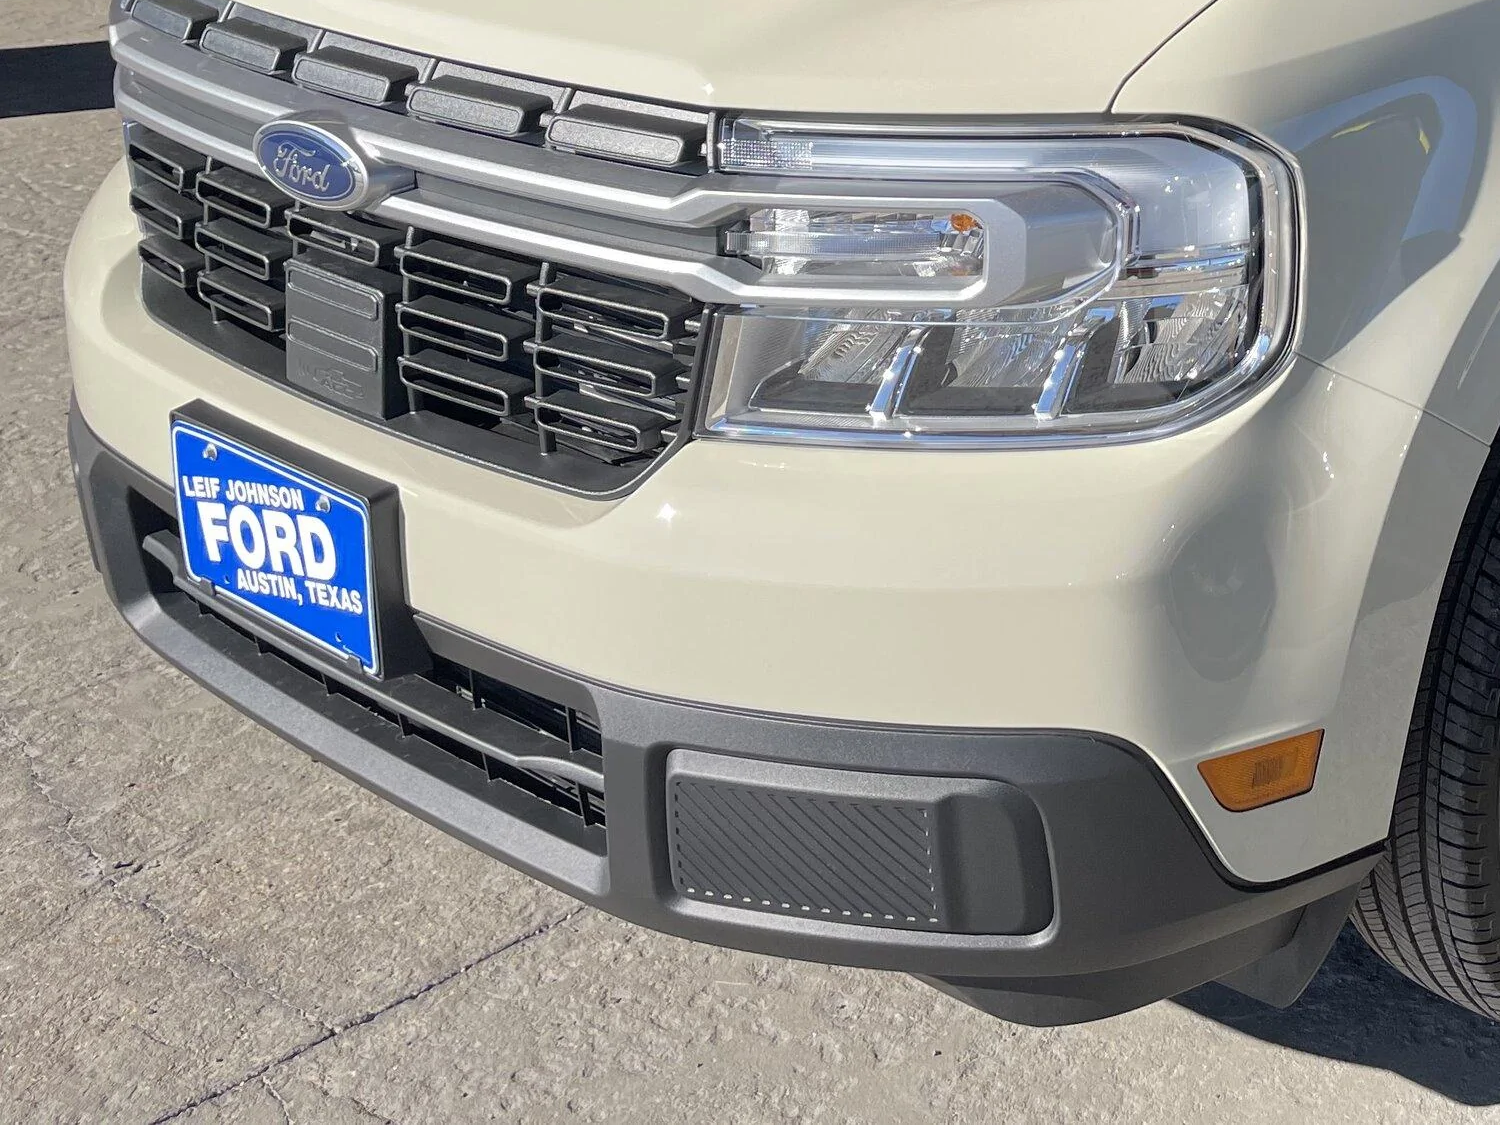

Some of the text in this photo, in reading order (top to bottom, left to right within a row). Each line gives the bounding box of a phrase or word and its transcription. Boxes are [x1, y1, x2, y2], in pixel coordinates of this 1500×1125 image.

[273, 140, 330, 192] Ford
[182, 475, 304, 511] LEIF JOHNSON
[197, 501, 337, 580] FORD
[237, 569, 363, 614] AUSTIN, TEXAS
